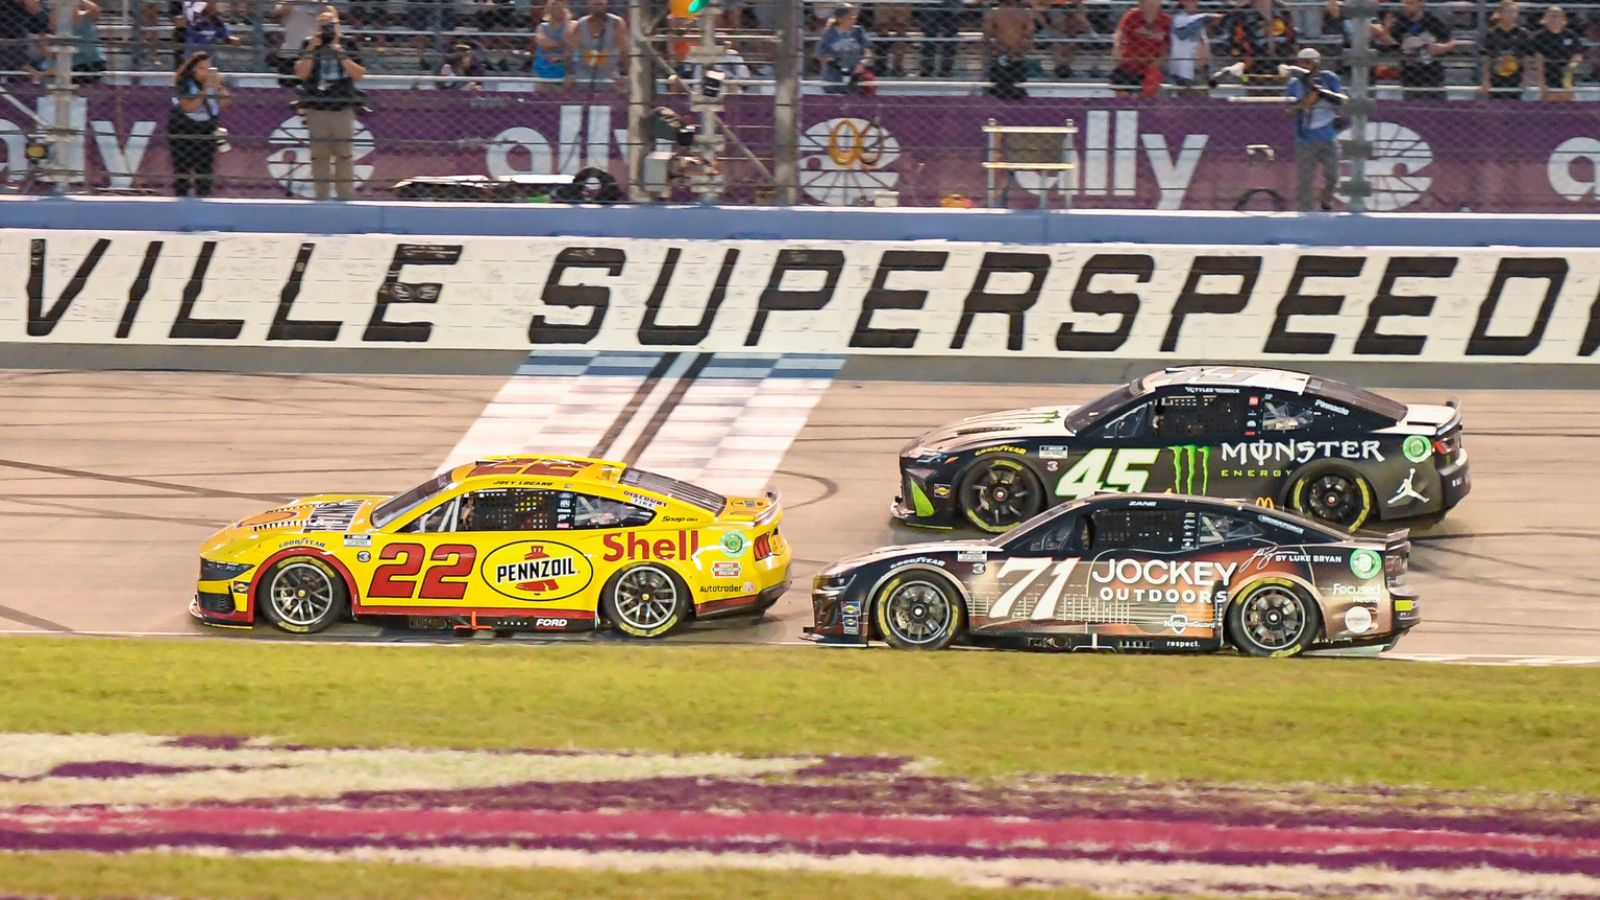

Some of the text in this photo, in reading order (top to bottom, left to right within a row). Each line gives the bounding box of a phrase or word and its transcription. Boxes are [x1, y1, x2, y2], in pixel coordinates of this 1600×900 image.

[486, 105, 672, 178] all
[26, 238, 1600, 357] VILLE SUPERSPEED
[1221, 439, 1386, 466] MONSTER
[1055, 448, 1160, 501] 45
[1221, 469, 1292, 478] ENERGY
[633, 499, 654, 508] TIRE
[279, 538, 326, 549] GOODYEAR
[602, 530, 699, 562] Shell
[366, 543, 477, 600] 22
[496, 557, 576, 583] PENNZOIL
[1092, 558, 1237, 586] JOCKEY
[1313, 555, 1342, 563] BRYAN
[700, 584, 742, 593] Autotrader
[988, 556, 1081, 620] 71
[1100, 587, 1227, 604] OUTDOORS
[1332, 583, 1380, 595] Focused
[536, 619, 568, 627] FORD
